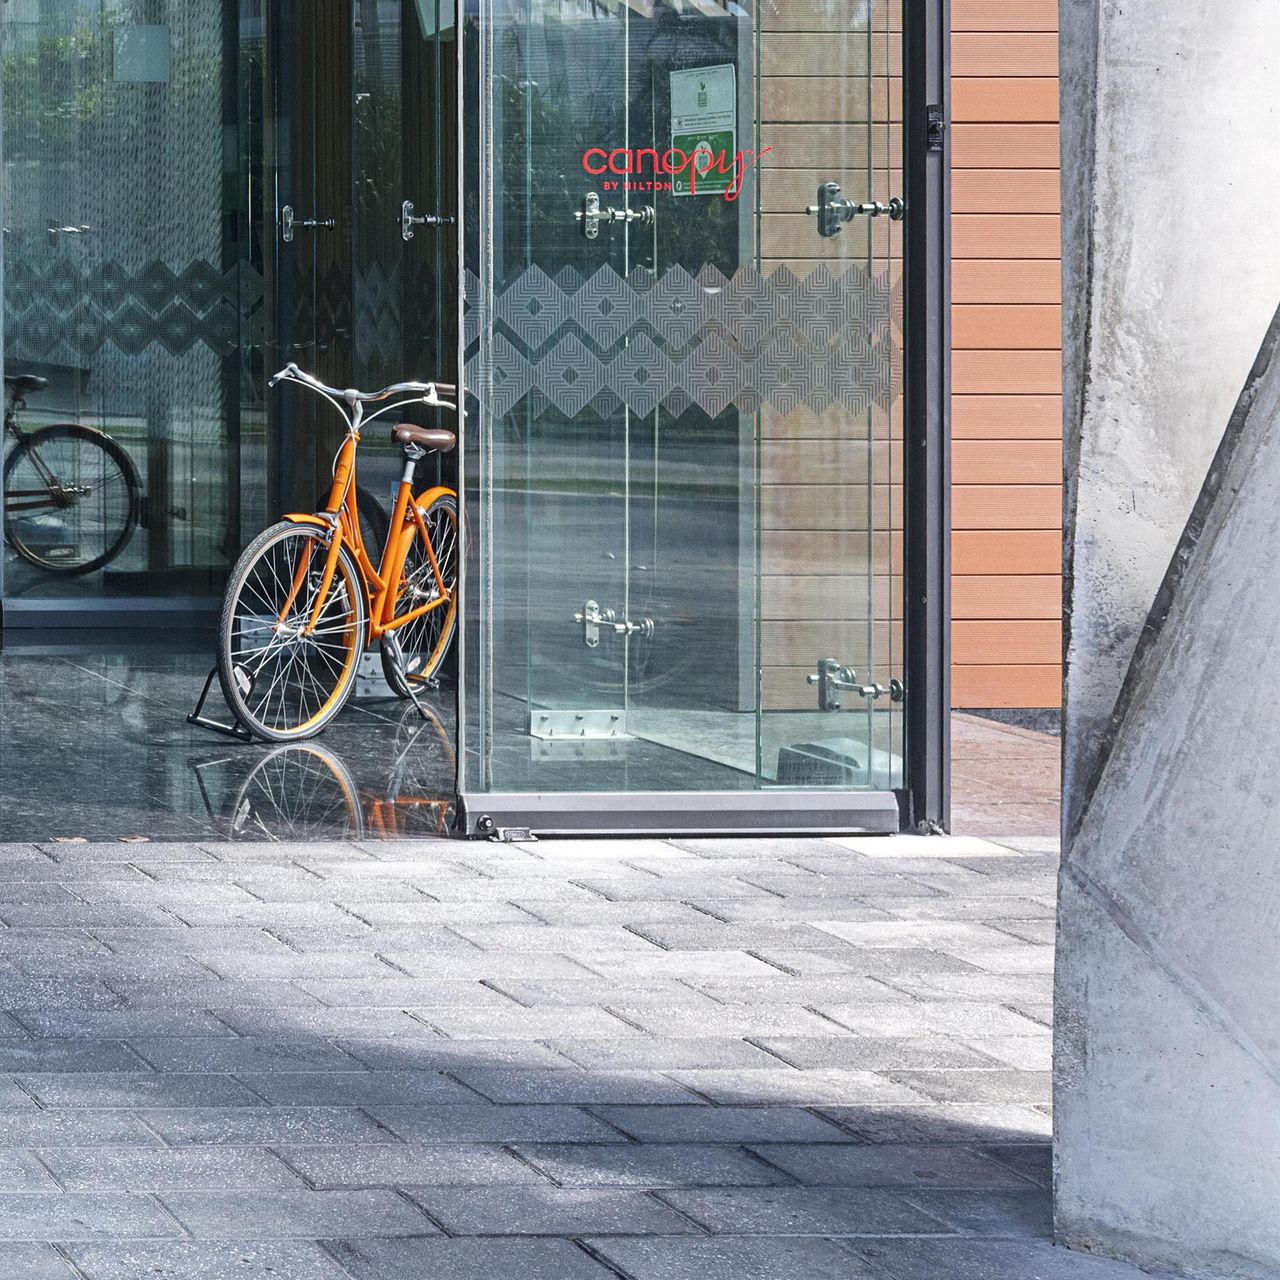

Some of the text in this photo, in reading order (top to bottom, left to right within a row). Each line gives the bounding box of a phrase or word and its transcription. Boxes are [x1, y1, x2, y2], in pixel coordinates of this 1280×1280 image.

[582, 145, 774, 203] canopy
[603, 181, 618, 191] BY
[624, 181, 672, 191] HILTON
